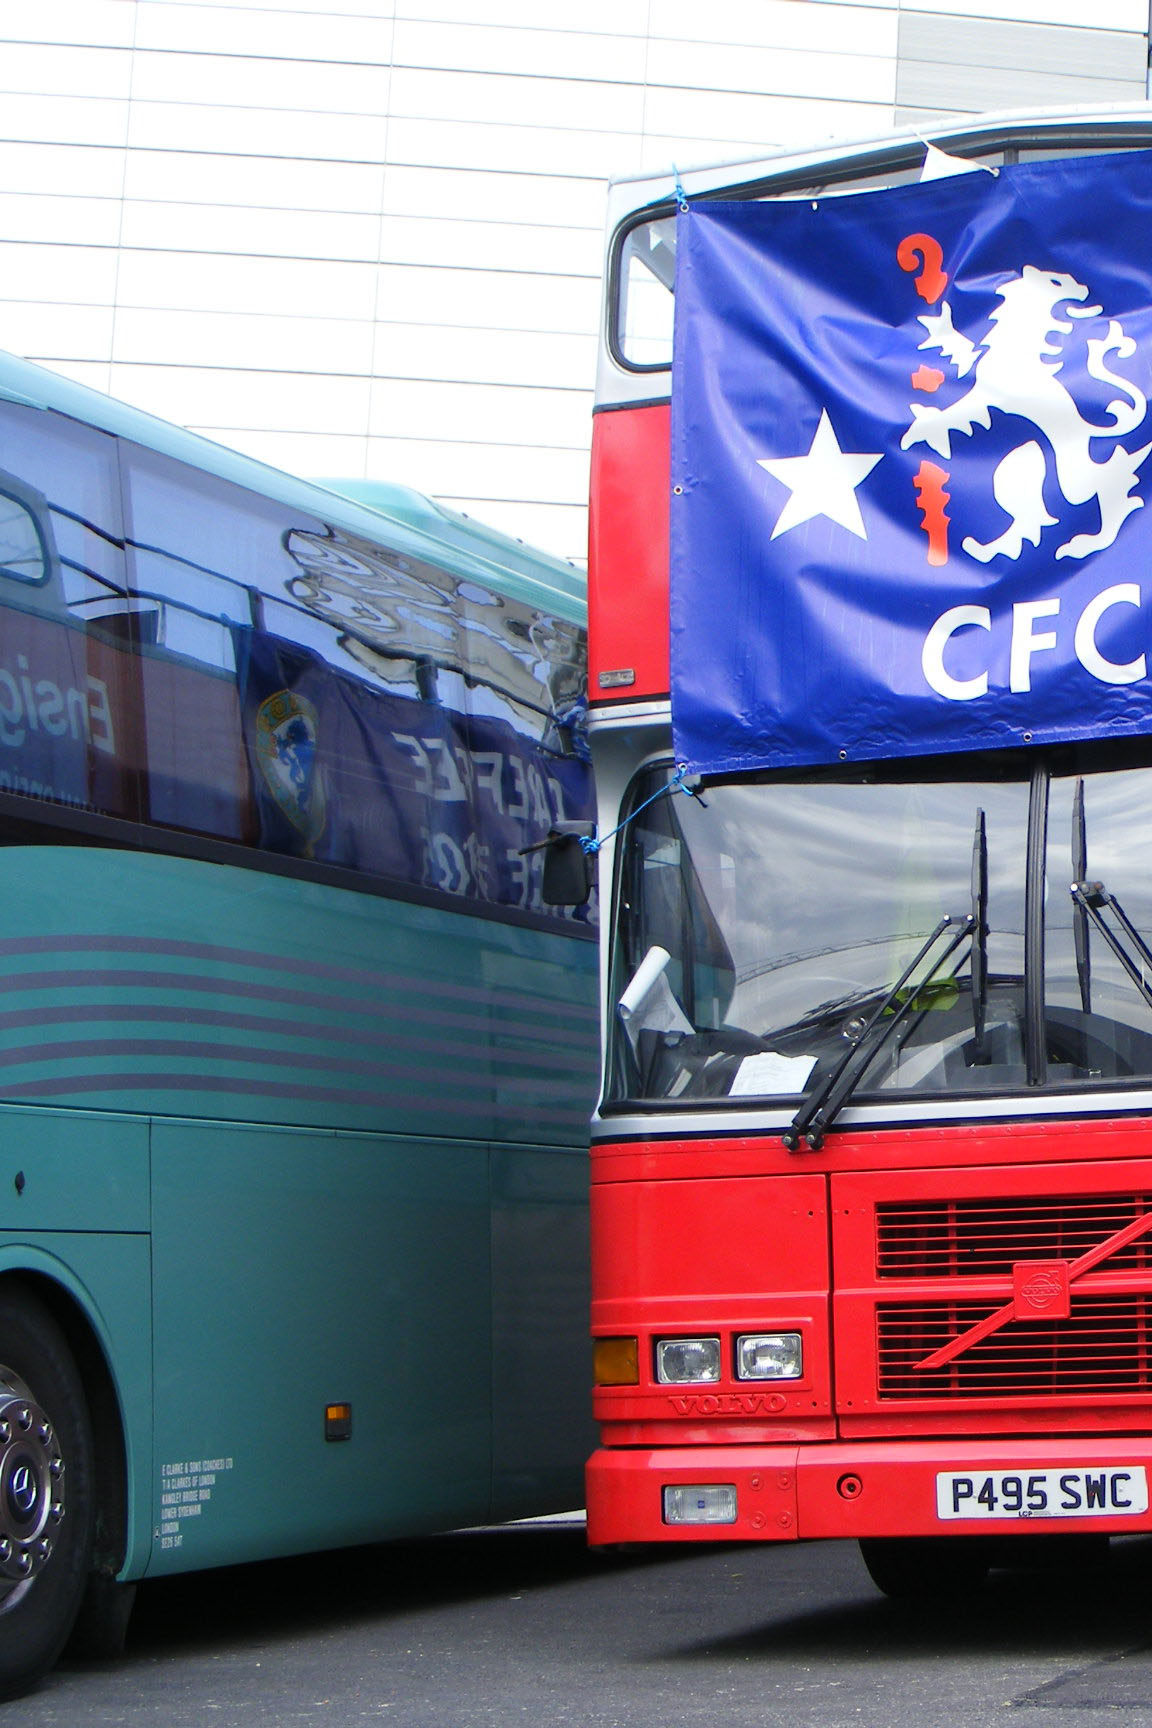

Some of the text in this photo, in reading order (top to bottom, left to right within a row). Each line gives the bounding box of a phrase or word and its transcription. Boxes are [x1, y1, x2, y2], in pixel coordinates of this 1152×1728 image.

[921, 582, 1148, 701] CFC
[668, 1393, 787, 1415] VOLVO
[952, 1473, 1132, 1513] P495 SWC
